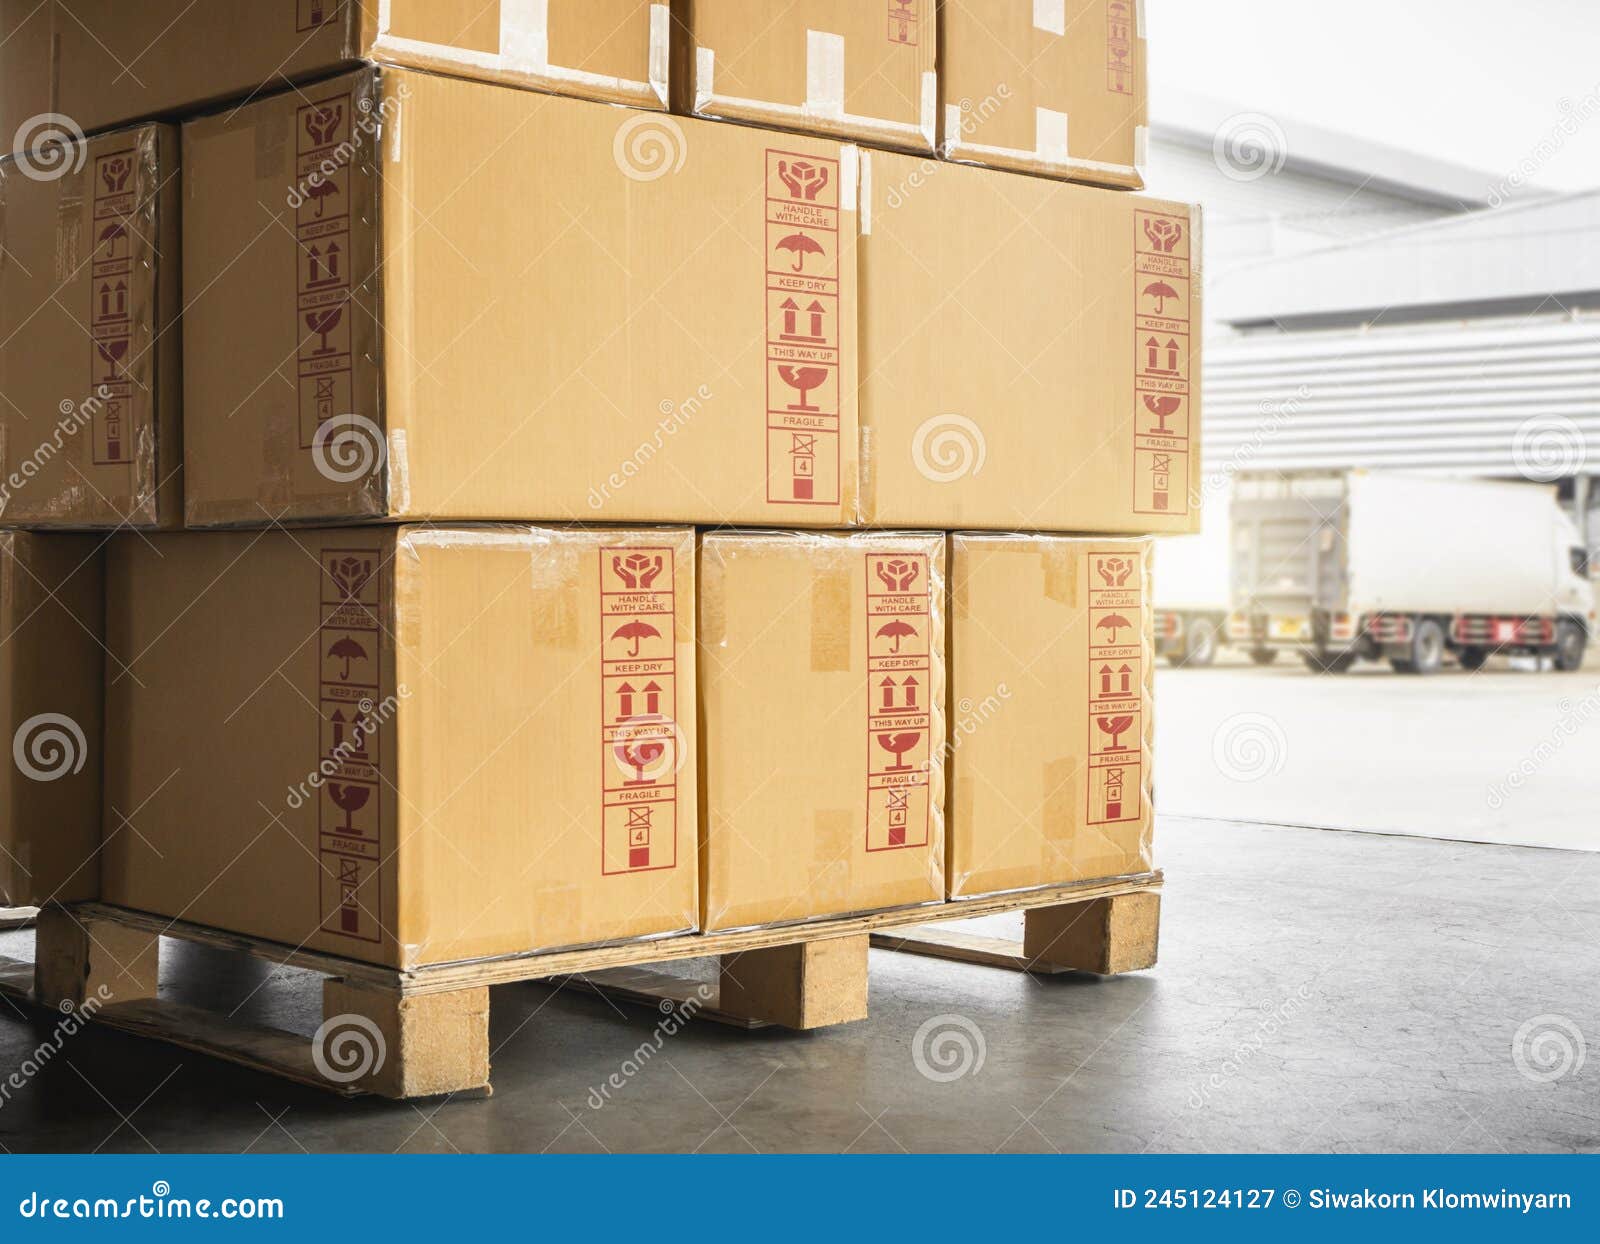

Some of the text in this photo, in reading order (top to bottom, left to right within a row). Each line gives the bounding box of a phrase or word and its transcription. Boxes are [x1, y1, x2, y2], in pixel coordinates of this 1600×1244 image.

[783, 205, 822, 217] HANDLE
[776, 212, 829, 226] WITH CARE
[1148, 256, 1177, 266] HANDLE
[1163, 266, 1182, 274] CARE
[779, 278, 826, 290] KEEP DRY
[774, 348, 794, 357] THIS
[820, 352, 832, 360] UP
[1141, 380, 1155, 388] THIS
[784, 417, 824, 426] FRAGILE
[1147, 439, 1176, 447] FRAGILE
[800, 461, 807, 471] 4
[1158, 477, 1164, 485] 4
[619, 595, 657, 603] HANDLE
[611, 604, 635, 612] WITH
[633, 728, 654, 736] WAY
[620, 790, 660, 800] FRAGILE
[895, 812, 900, 821] 4
[636, 832, 642, 841] 4
